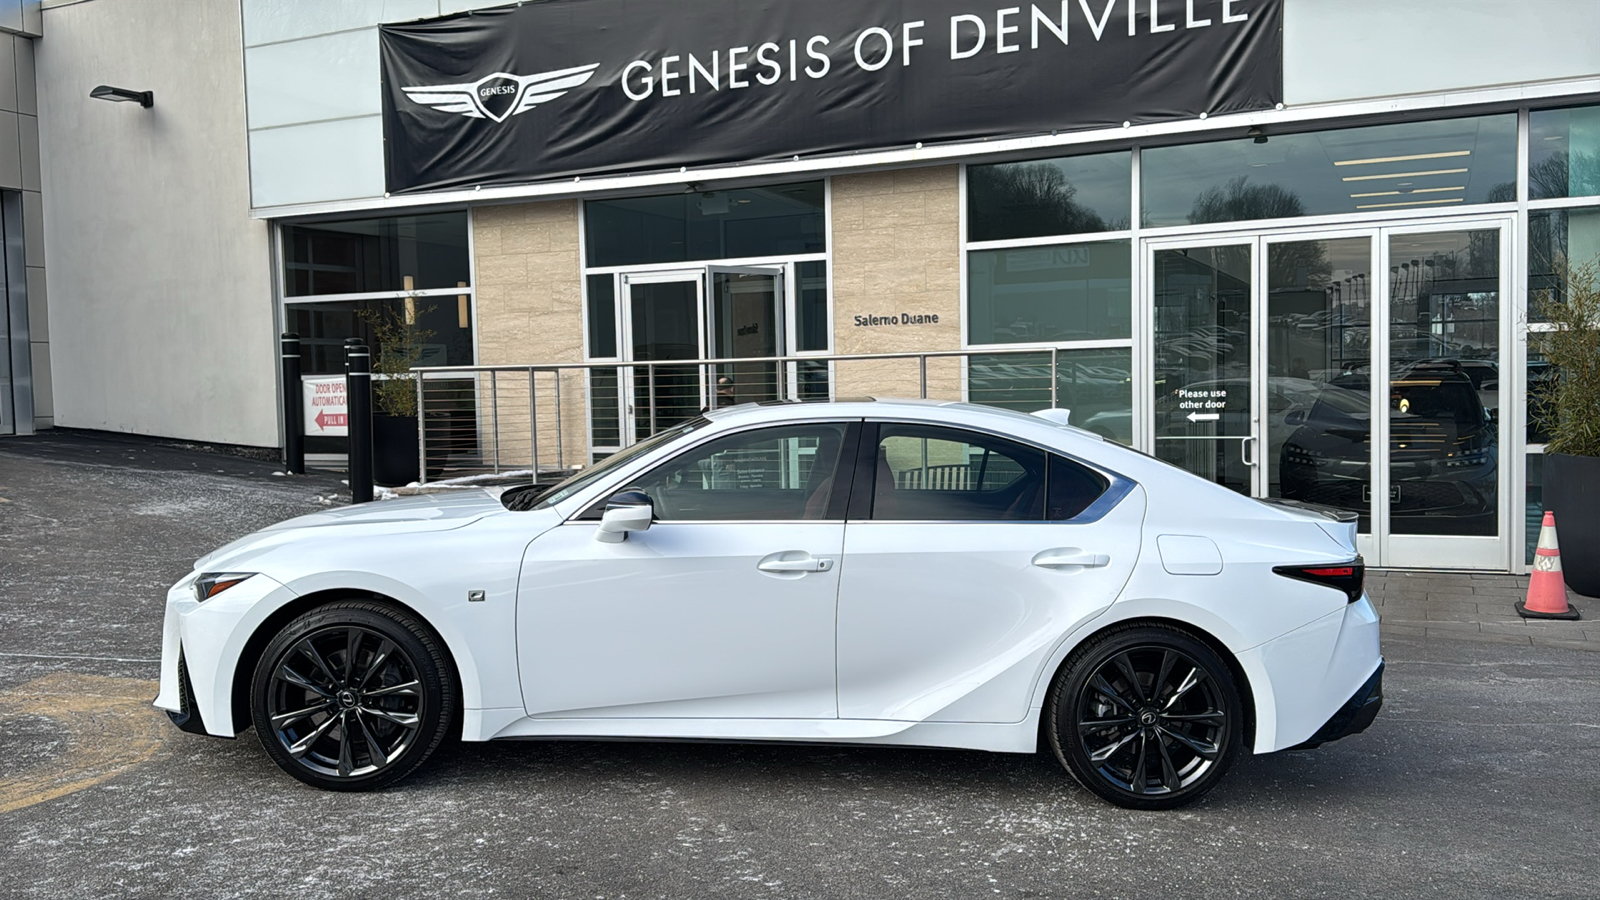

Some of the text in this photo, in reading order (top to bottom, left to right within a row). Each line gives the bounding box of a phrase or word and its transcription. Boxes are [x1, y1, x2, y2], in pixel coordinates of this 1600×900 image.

[621, 0, 1249, 101] GENESIS OF DENVILLE
[480, 84, 516, 97] GENESIS
[854, 312, 939, 326] Salerno Duane
[316, 383, 346, 394] DOOR OPEN
[1179, 389, 1209, 398] Please
[312, 396, 346, 406] AUTOMATICA
[1179, 400, 1226, 409] other door
[324, 415, 344, 424] PULL IN
